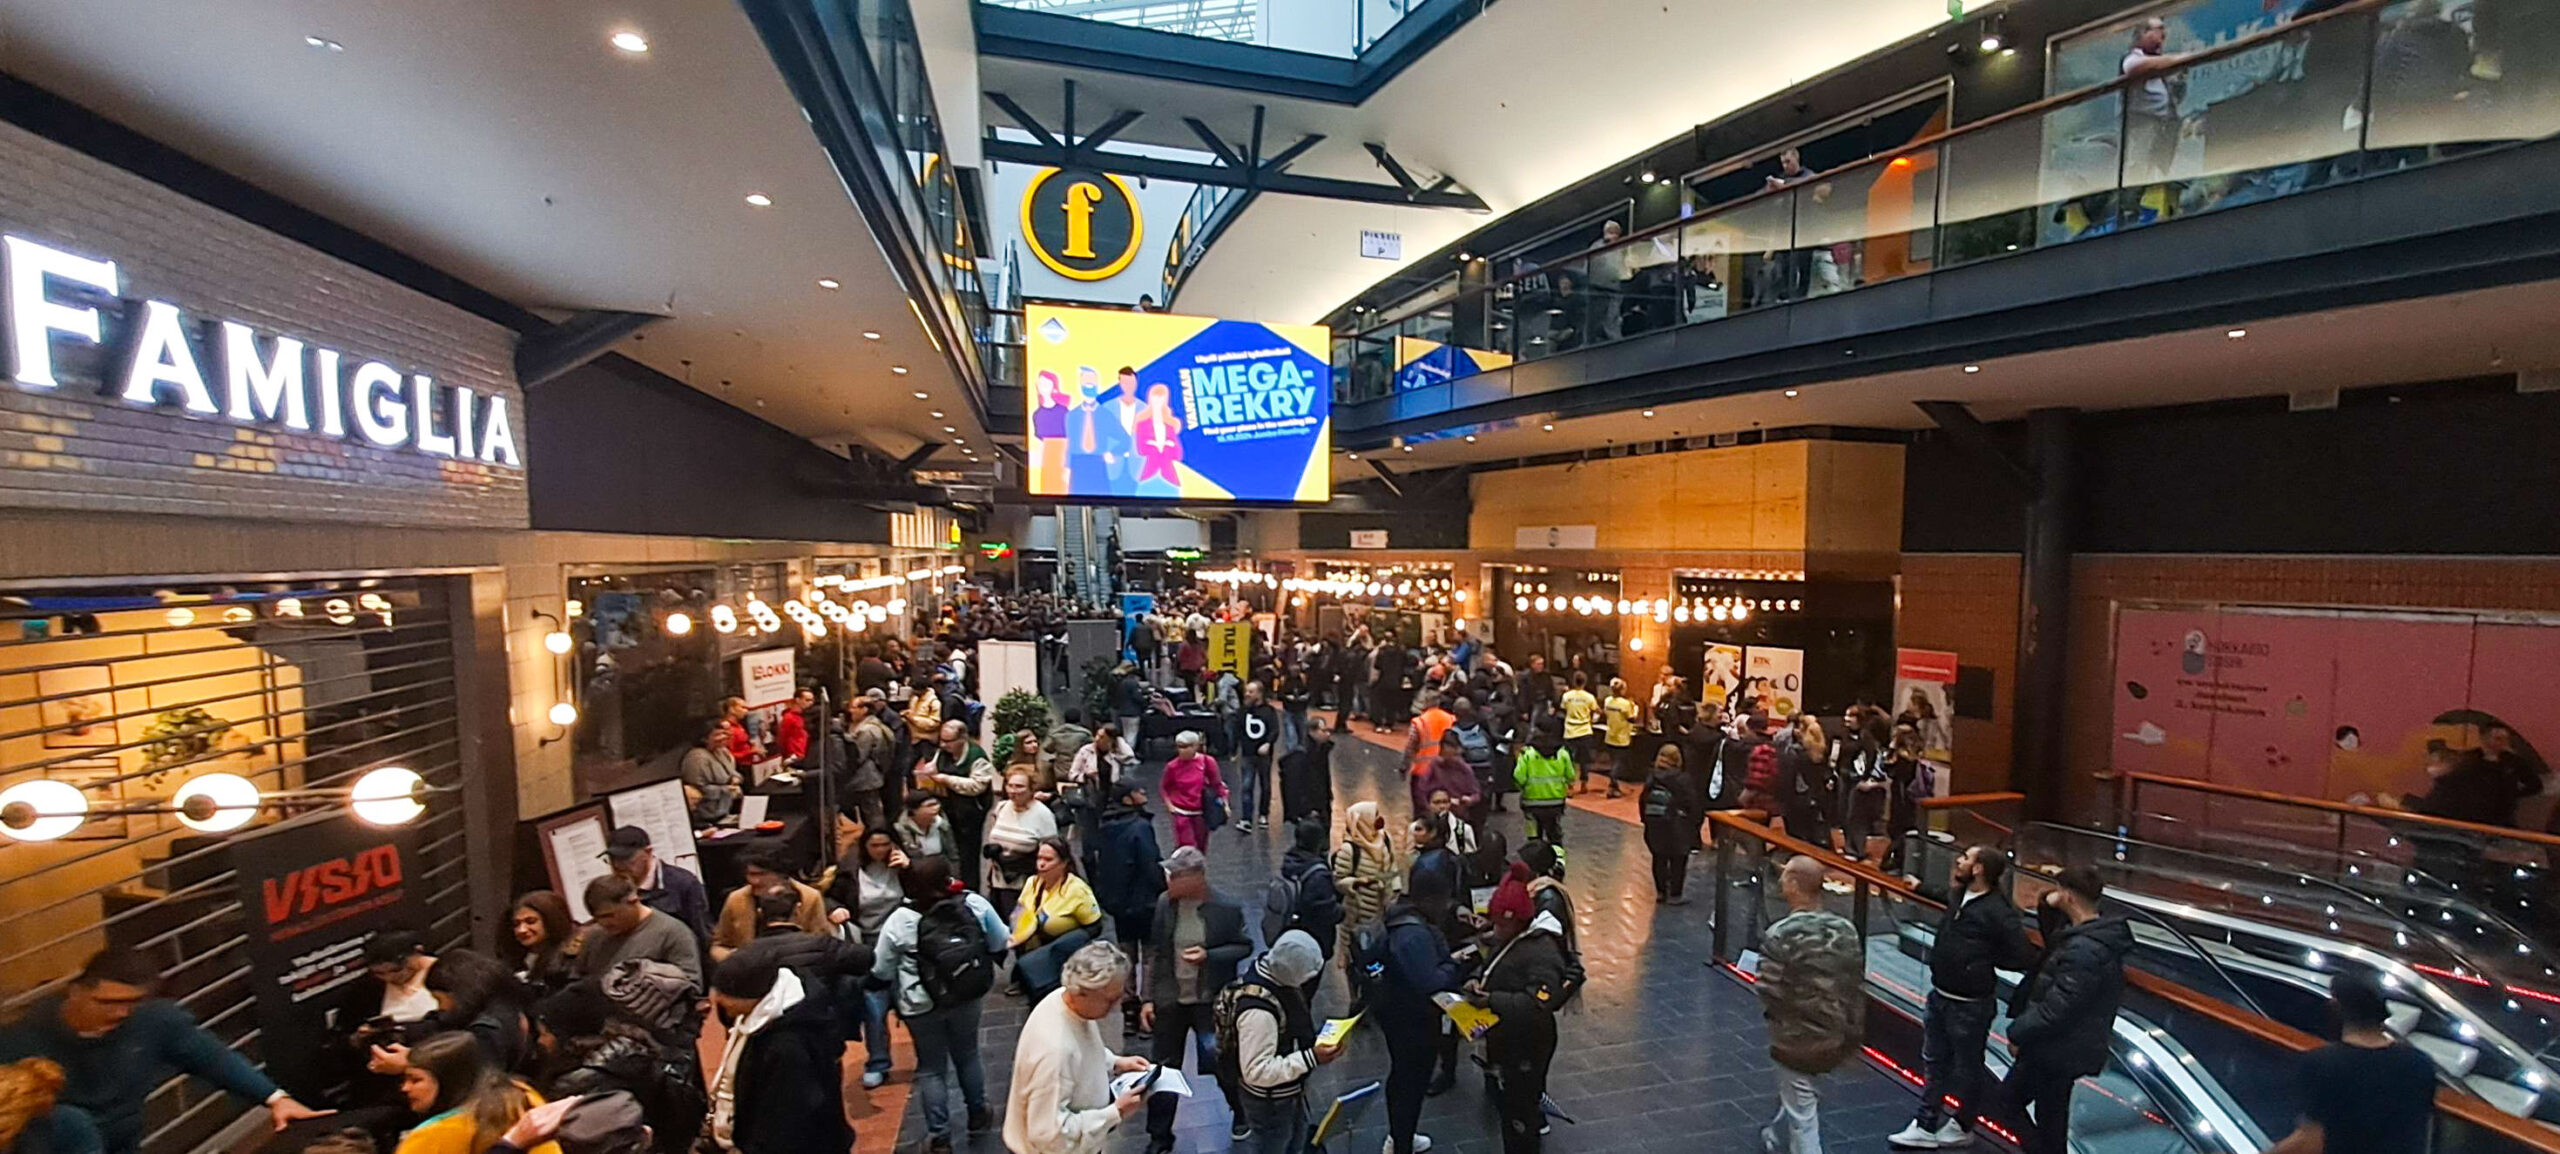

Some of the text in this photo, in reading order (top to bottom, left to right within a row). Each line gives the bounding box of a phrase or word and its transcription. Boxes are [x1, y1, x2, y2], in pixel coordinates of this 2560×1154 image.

[1061, 182, 1103, 258] f
[3, 234, 523, 467] FAMIGLIA
[1191, 359, 1315, 396] MEGA-
[1197, 386, 1316, 426] REKRY
[1223, 626, 1237, 657] TULE
[1245, 713, 1266, 739] b
